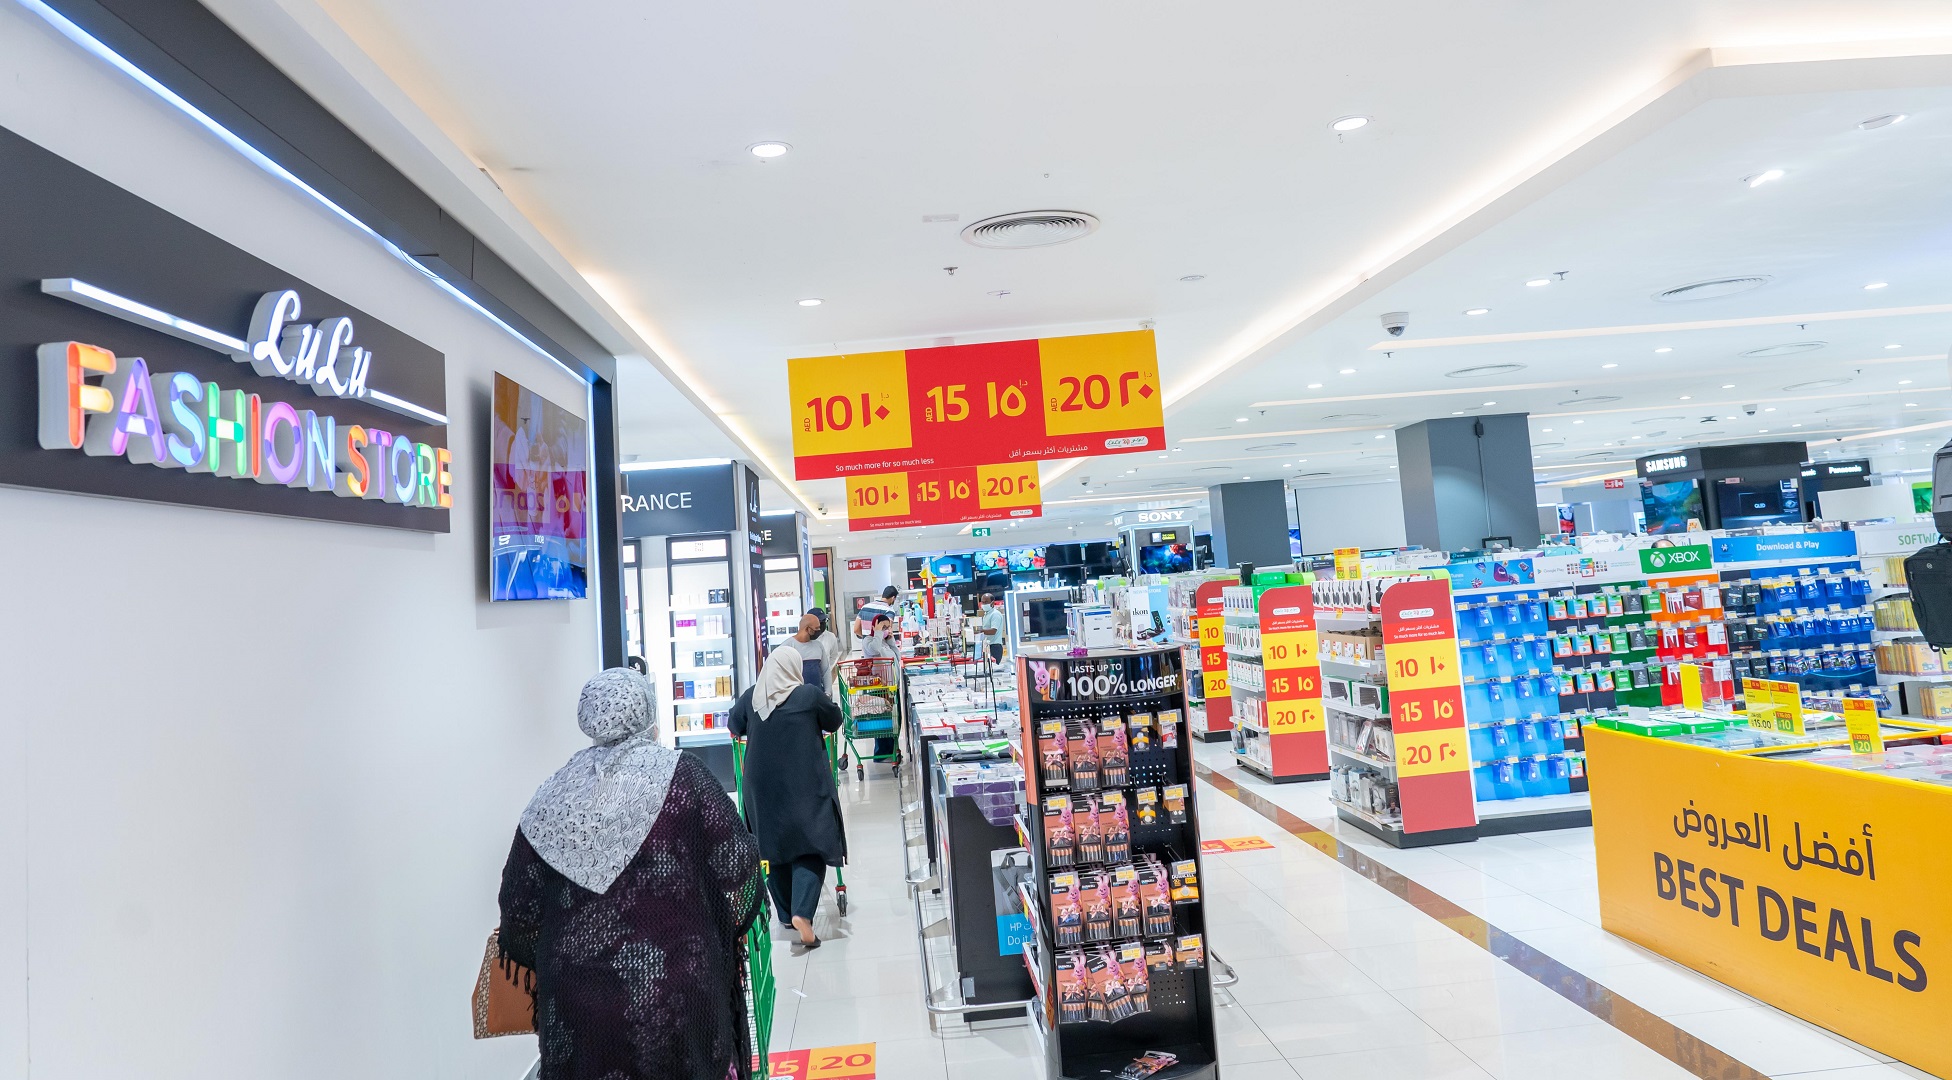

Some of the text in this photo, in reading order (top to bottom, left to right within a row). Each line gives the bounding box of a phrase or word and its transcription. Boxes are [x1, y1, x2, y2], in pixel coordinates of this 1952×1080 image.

[250, 289, 373, 398] LuLu
[1059, 374, 1111, 412] 20
[1119, 371, 1154, 408] ٢٠
[926, 384, 970, 423] 15
[986, 381, 1027, 419] ١٥
[806, 395, 853, 433] 10
[45, 340, 454, 508] FASHION STORE
[1022, 448, 1042, 457] بسعر
[1057, 444, 1089, 454] مشتريات
[835, 464, 844, 472] So
[845, 463, 863, 471] much
[882, 460, 892, 468] for
[902, 458, 920, 466] much
[920, 457, 935, 465] less
[1645, 455, 1688, 473] SAMSUNG
[917, 481, 940, 502] 15
[948, 479, 970, 500] ١٥
[986, 476, 1014, 497] 20
[621, 491, 692, 513] RANCE
[854, 486, 879, 507] 10
[1138, 511, 1185, 522] SONY
[1755, 540, 1820, 551] Download & Play
[1897, 532, 1938, 546] SOFTWA
[1668, 550, 1701, 563] XBOX
[1204, 626, 1219, 639] 10
[1044, 643, 1068, 652] UHD TV
[1269, 645, 1288, 660] 10
[1207, 652, 1221, 666] 15
[1395, 658, 1419, 678] 10
[1069, 663, 1122, 674] LASTS UP TO
[1067, 673, 1128, 697] 100%
[1210, 678, 1227, 691] 20
[1272, 677, 1290, 693] 15
[1276, 710, 1296, 726] 20
[1400, 701, 1423, 722] 15
[1432, 699, 1454, 720] ١٥
[1780, 719, 1791, 730] 10
[1406, 744, 1432, 765] 20
[1857, 741, 1871, 752] 20
[1232, 839, 1265, 847] 20
[1673, 799, 1877, 880] أفضل العروض
[1010, 922, 1022, 932] HP
[1653, 851, 1928, 993] BEST DEALS
[1007, 935, 1021, 945] Do
[768, 1053, 872, 1076] 15 20
